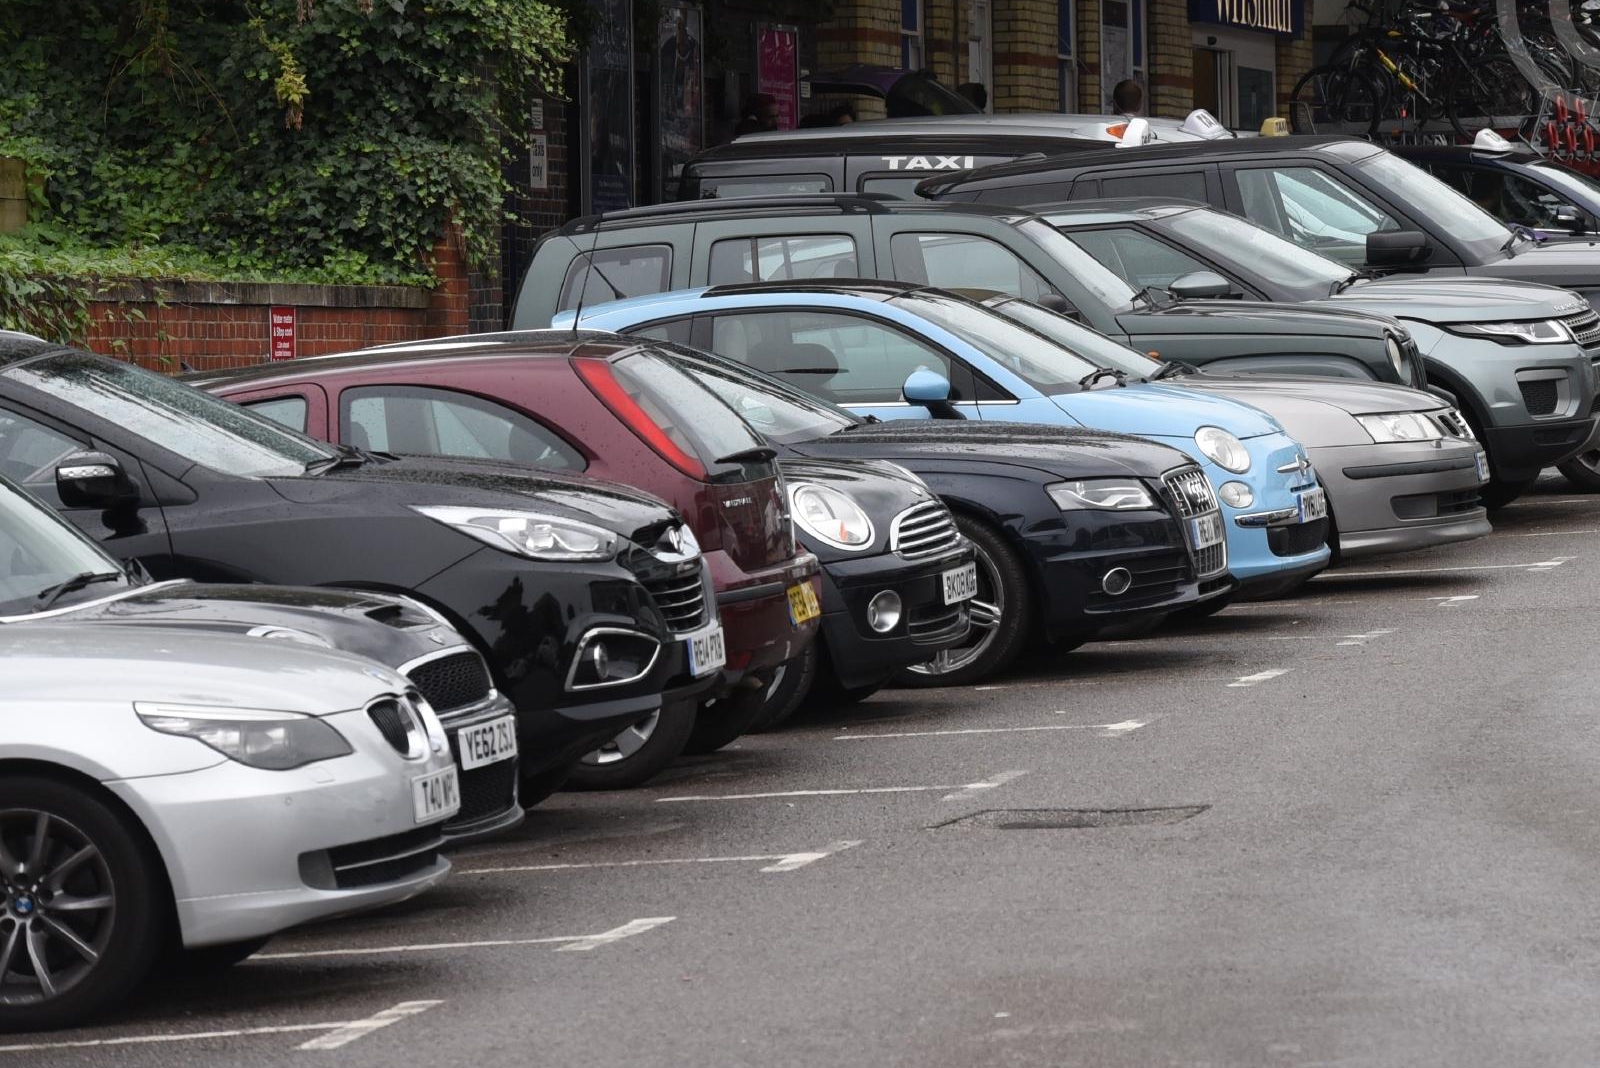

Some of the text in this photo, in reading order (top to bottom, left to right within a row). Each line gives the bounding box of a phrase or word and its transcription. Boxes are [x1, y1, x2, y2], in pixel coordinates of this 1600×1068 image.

[532, 163, 543, 181] only
[881, 155, 974, 170] TAXI
[465, 725, 496, 762] YE62
[422, 777, 442, 813] T40
